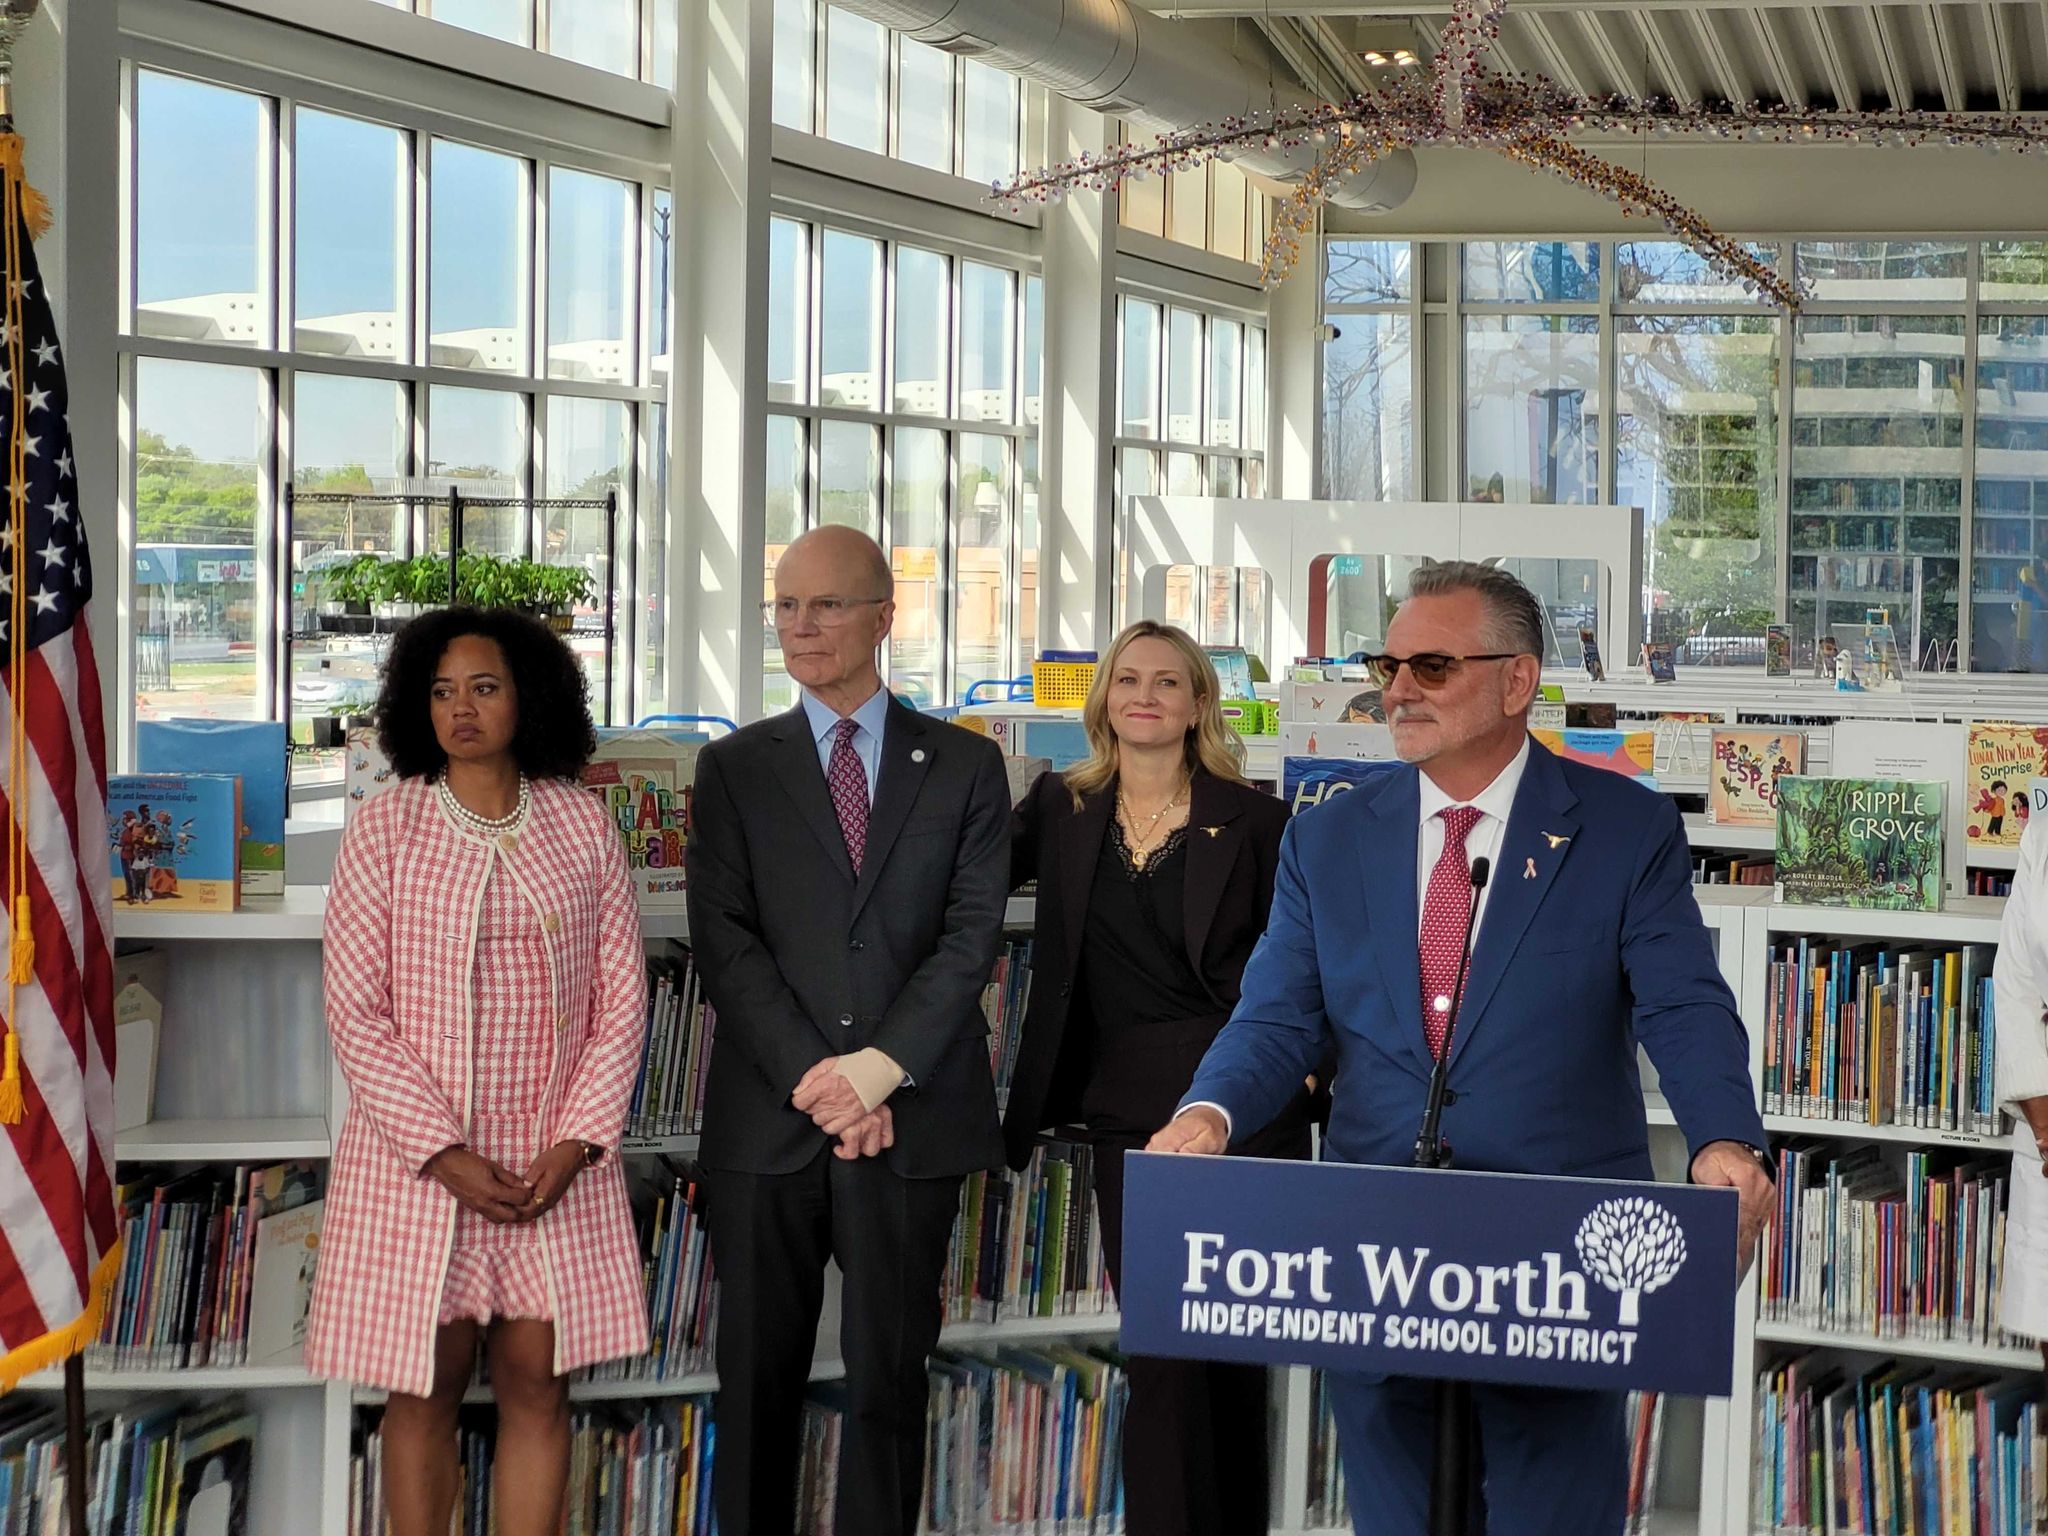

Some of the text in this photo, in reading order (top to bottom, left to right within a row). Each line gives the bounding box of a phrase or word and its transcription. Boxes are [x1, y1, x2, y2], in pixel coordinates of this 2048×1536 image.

[1969, 742, 2036, 766] LUNAR NEW YEAR
[1980, 739, 1994, 749] The
[1980, 762, 2032, 781] Surprise
[1851, 791, 1926, 817] RIPPLE
[1849, 817, 1925, 843] GROVE
[1183, 1232, 1590, 1321] Fort Worth
[1182, 1300, 1637, 1365] INDEPENDENT SCHOOL DISTRICT
